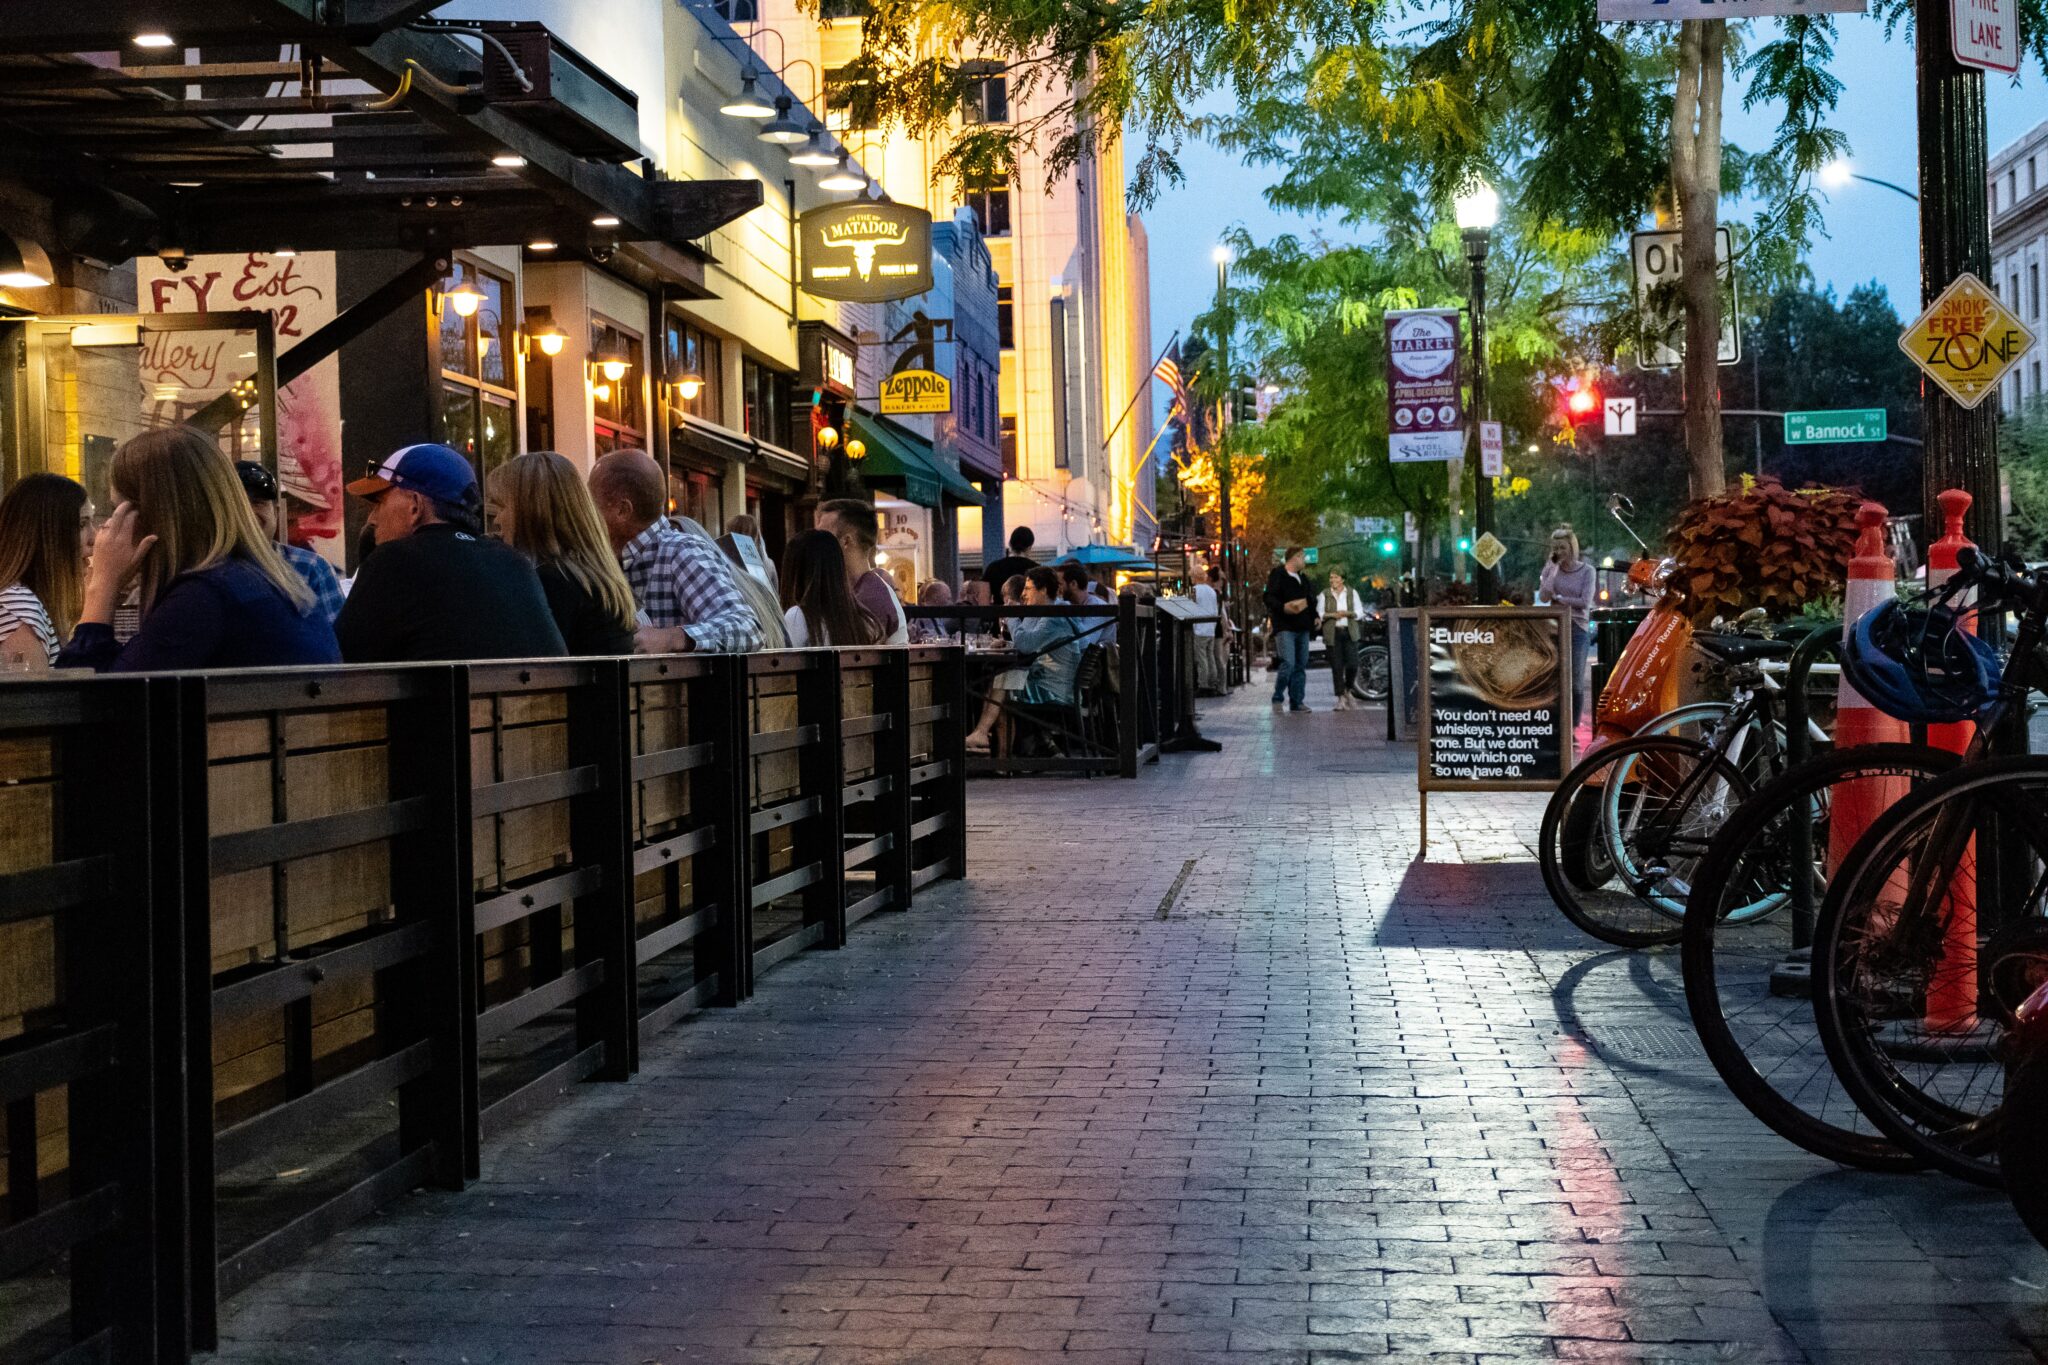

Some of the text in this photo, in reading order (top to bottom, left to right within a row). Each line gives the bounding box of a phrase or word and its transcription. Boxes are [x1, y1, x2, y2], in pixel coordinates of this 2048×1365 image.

[1970, 20, 2002, 50] LANE
[830, 221, 898, 239] MATADOR
[232, 252, 322, 302] Est
[1942, 299, 1990, 315] SMOKE
[1412, 327, 1431, 338] The
[1928, 316, 1987, 335] FREE
[1391, 338, 1453, 352] MARKET
[1926, 330, 2019, 371] ZONE
[885, 375, 945, 402] Zeppole
[1805, 422, 1865, 439] Bannock
[1871, 427, 1881, 437] St
[896, 514, 908, 525] 10
[1435, 628, 1495, 644] Eureka
[1635, 615, 1680, 679] Scooter Rental
[1436, 709, 1550, 722] You don't need 40
[1435, 723, 1553, 738] whiskeys, you need
[1435, 737, 1540, 749] one. But we don't
[1435, 751, 1537, 765] know which one,
[1435, 765, 1523, 777] so we have 40.
